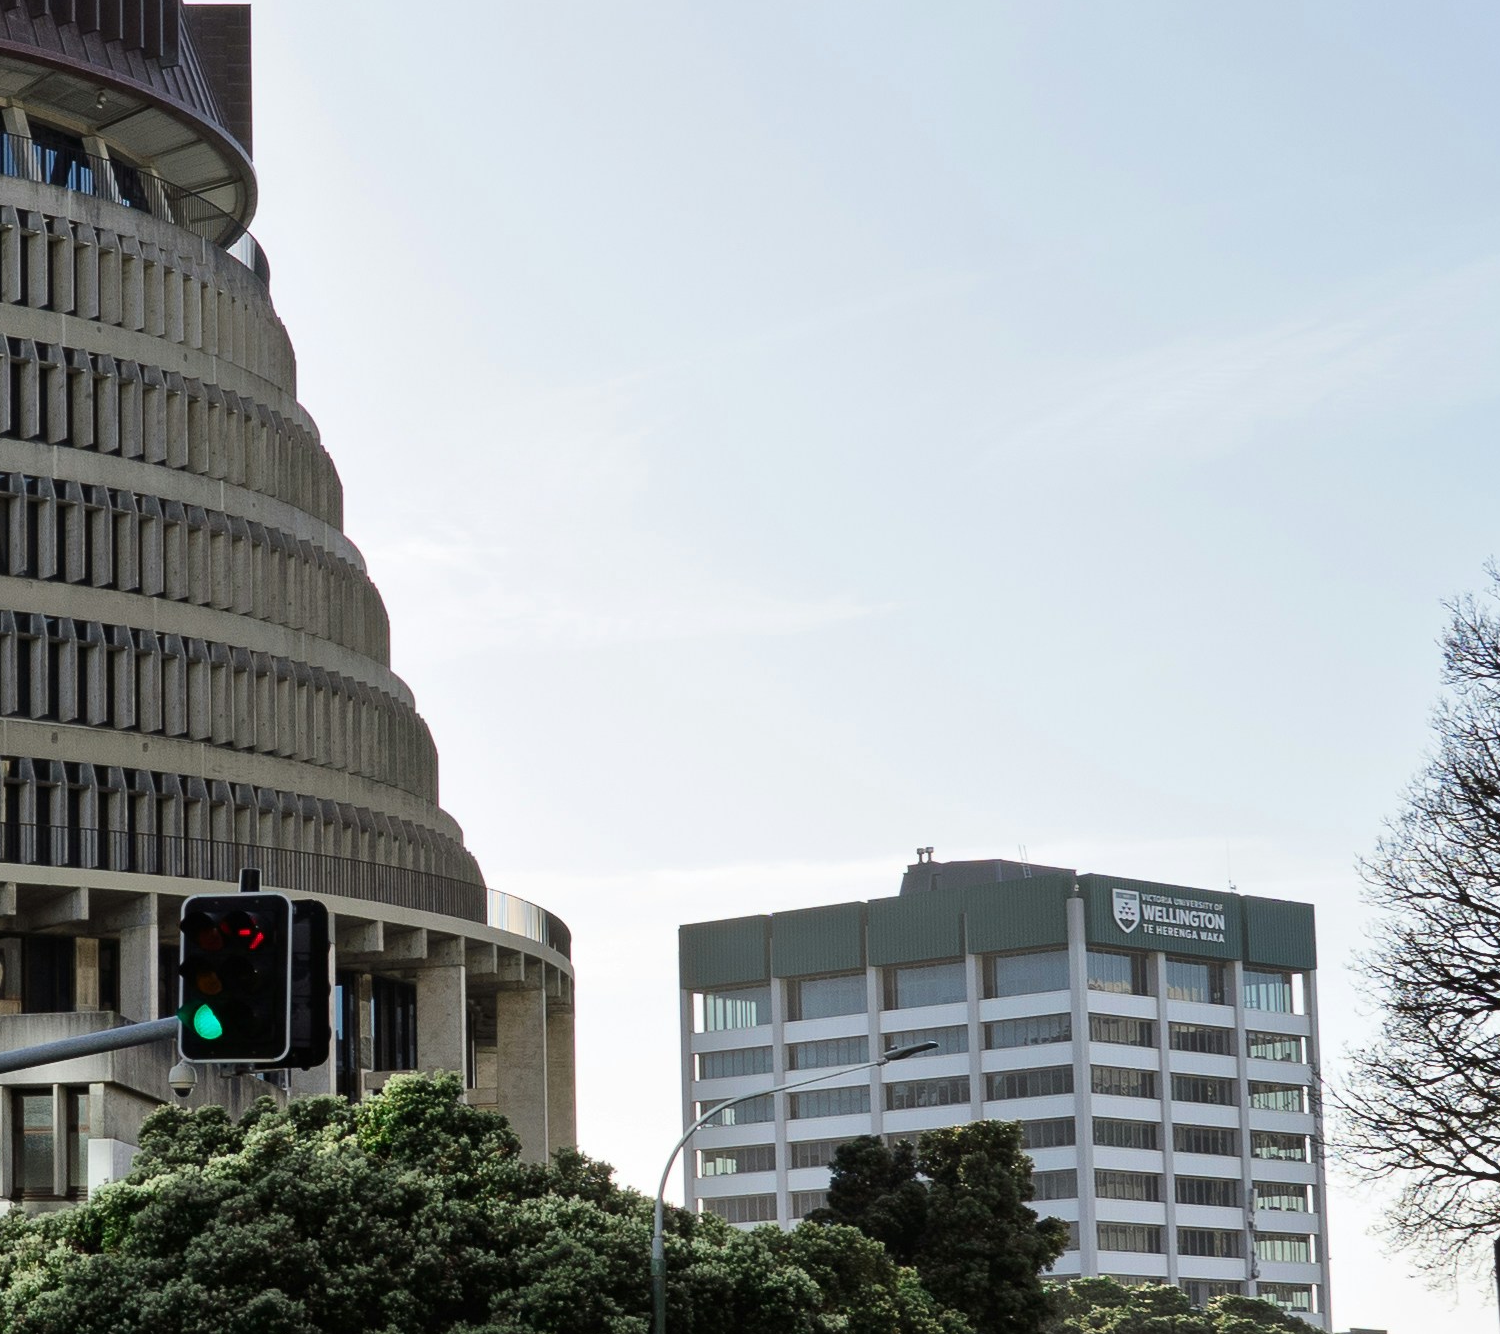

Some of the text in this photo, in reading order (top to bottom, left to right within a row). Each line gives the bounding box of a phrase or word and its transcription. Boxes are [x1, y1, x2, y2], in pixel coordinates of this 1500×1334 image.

[1141, 893, 1223, 911] VICTORIA UNIVERSITY OF
[1141, 904, 1225, 930] WELLINGTON
[1142, 923, 1225, 943] TE HERENGA WAKA
